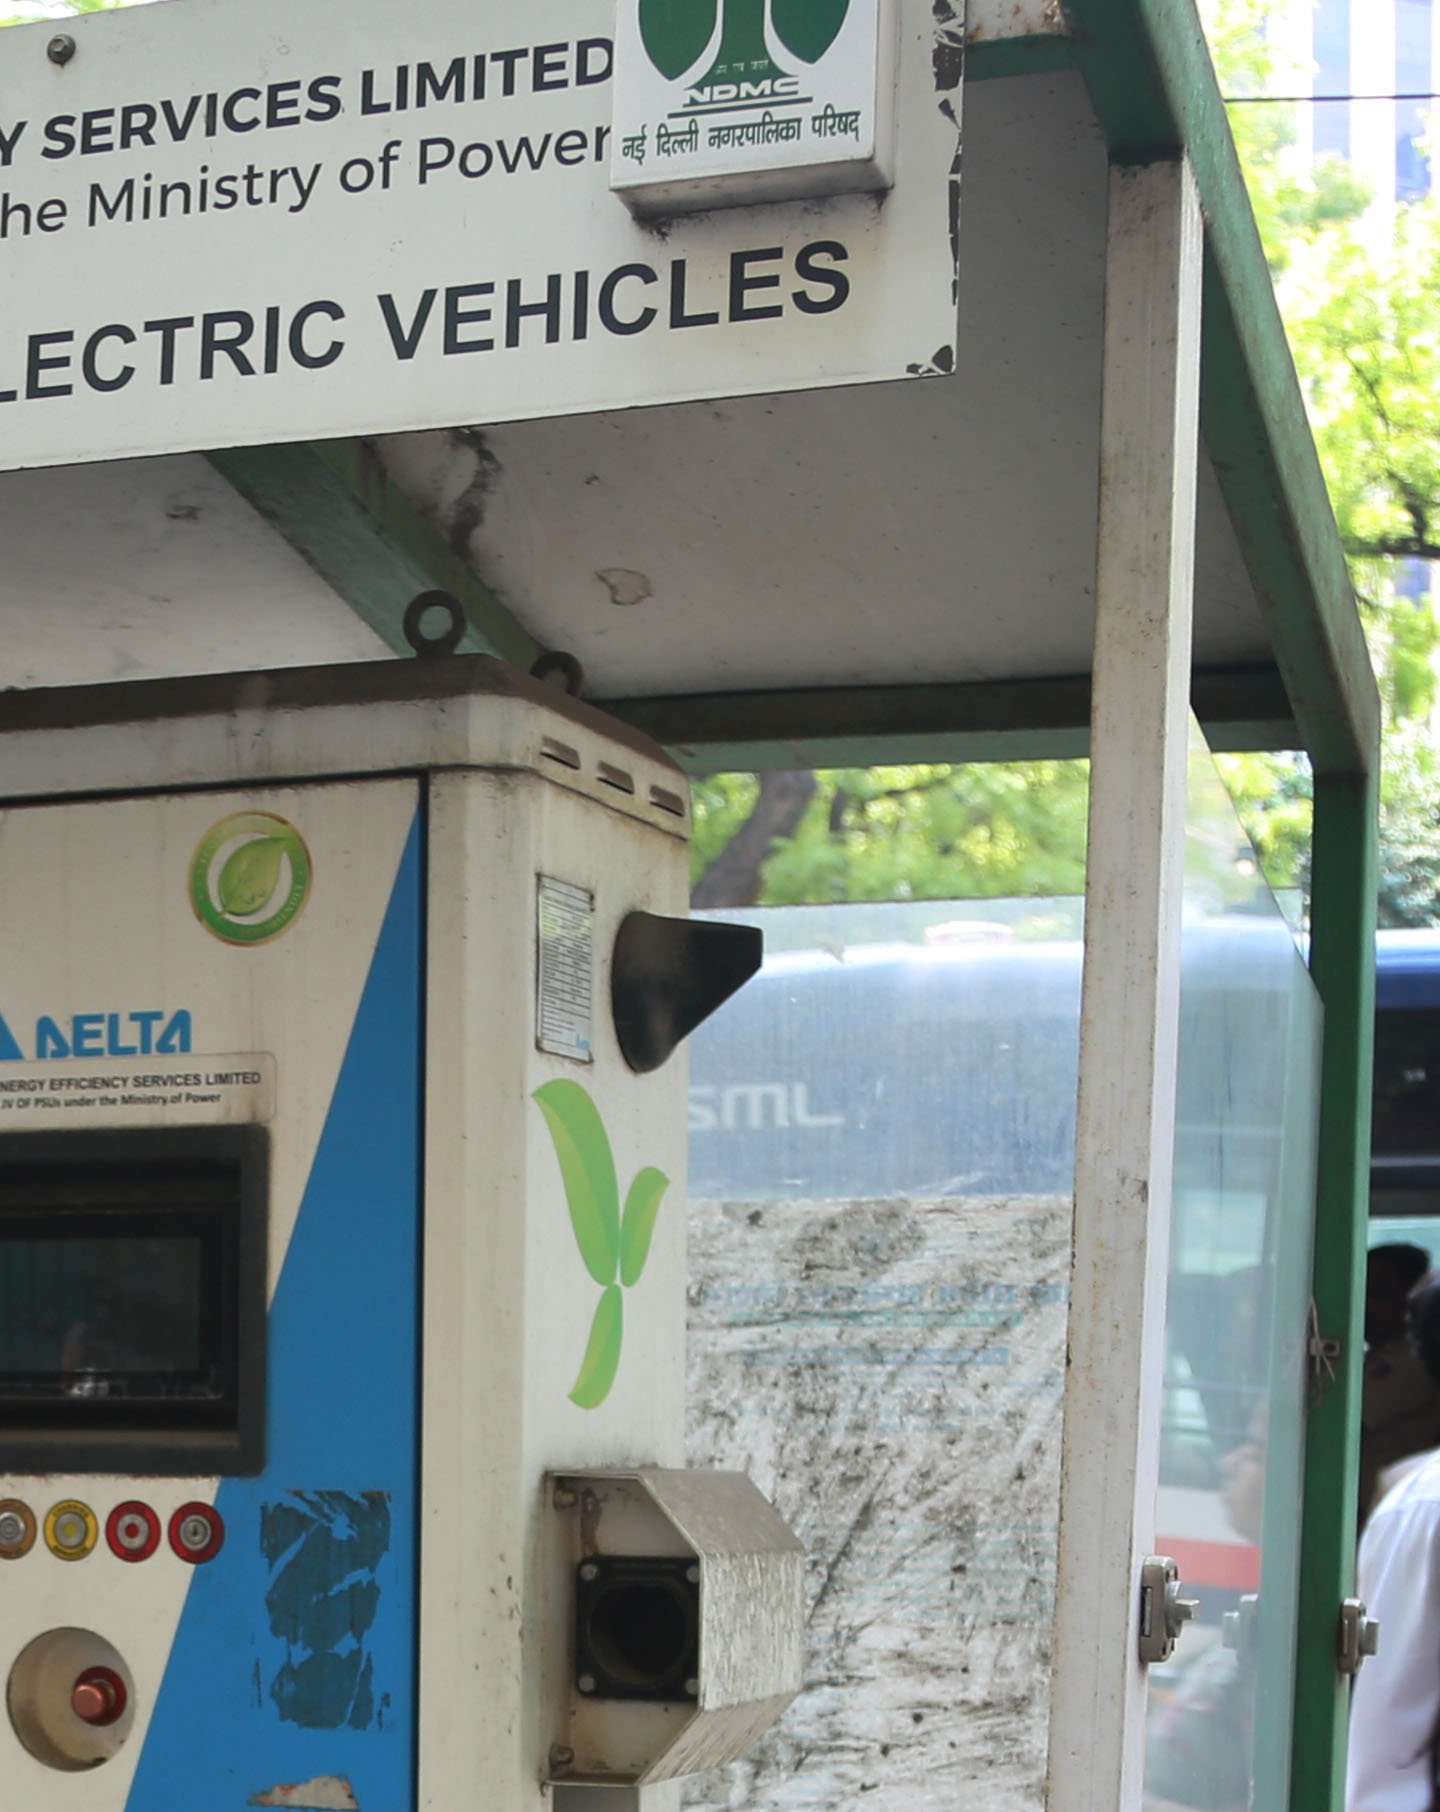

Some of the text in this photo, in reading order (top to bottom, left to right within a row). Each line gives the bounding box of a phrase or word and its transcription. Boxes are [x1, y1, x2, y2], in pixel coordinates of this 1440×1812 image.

[40, 75, 342, 160] SERVICES
[360, 36, 613, 116] LIMITED
[684, 77, 800, 104] NDMC
[622, 124, 647, 165] नई
[656, 118, 700, 157] दिल्ली
[708, 111, 802, 149] नगरपालिका
[87, 158, 317, 227] Ministry
[339, 137, 399, 194] of
[418, 124, 613, 184] Power
[377, 239, 852, 361] VEHICLES
[36, 1009, 192, 1058] DELTA
[50, 1076, 128, 1091] EFFICIENCY
[133, 1073, 201, 1088] SERVICES
[206, 1071, 261, 1086] LIMITED
[64, 1095, 97, 1107] under
[99, 1095, 118, 1106] the
[121, 1093, 167, 1107] Ministry
[169, 1092, 182, 1103] of
[185, 1091, 221, 1103] Power
